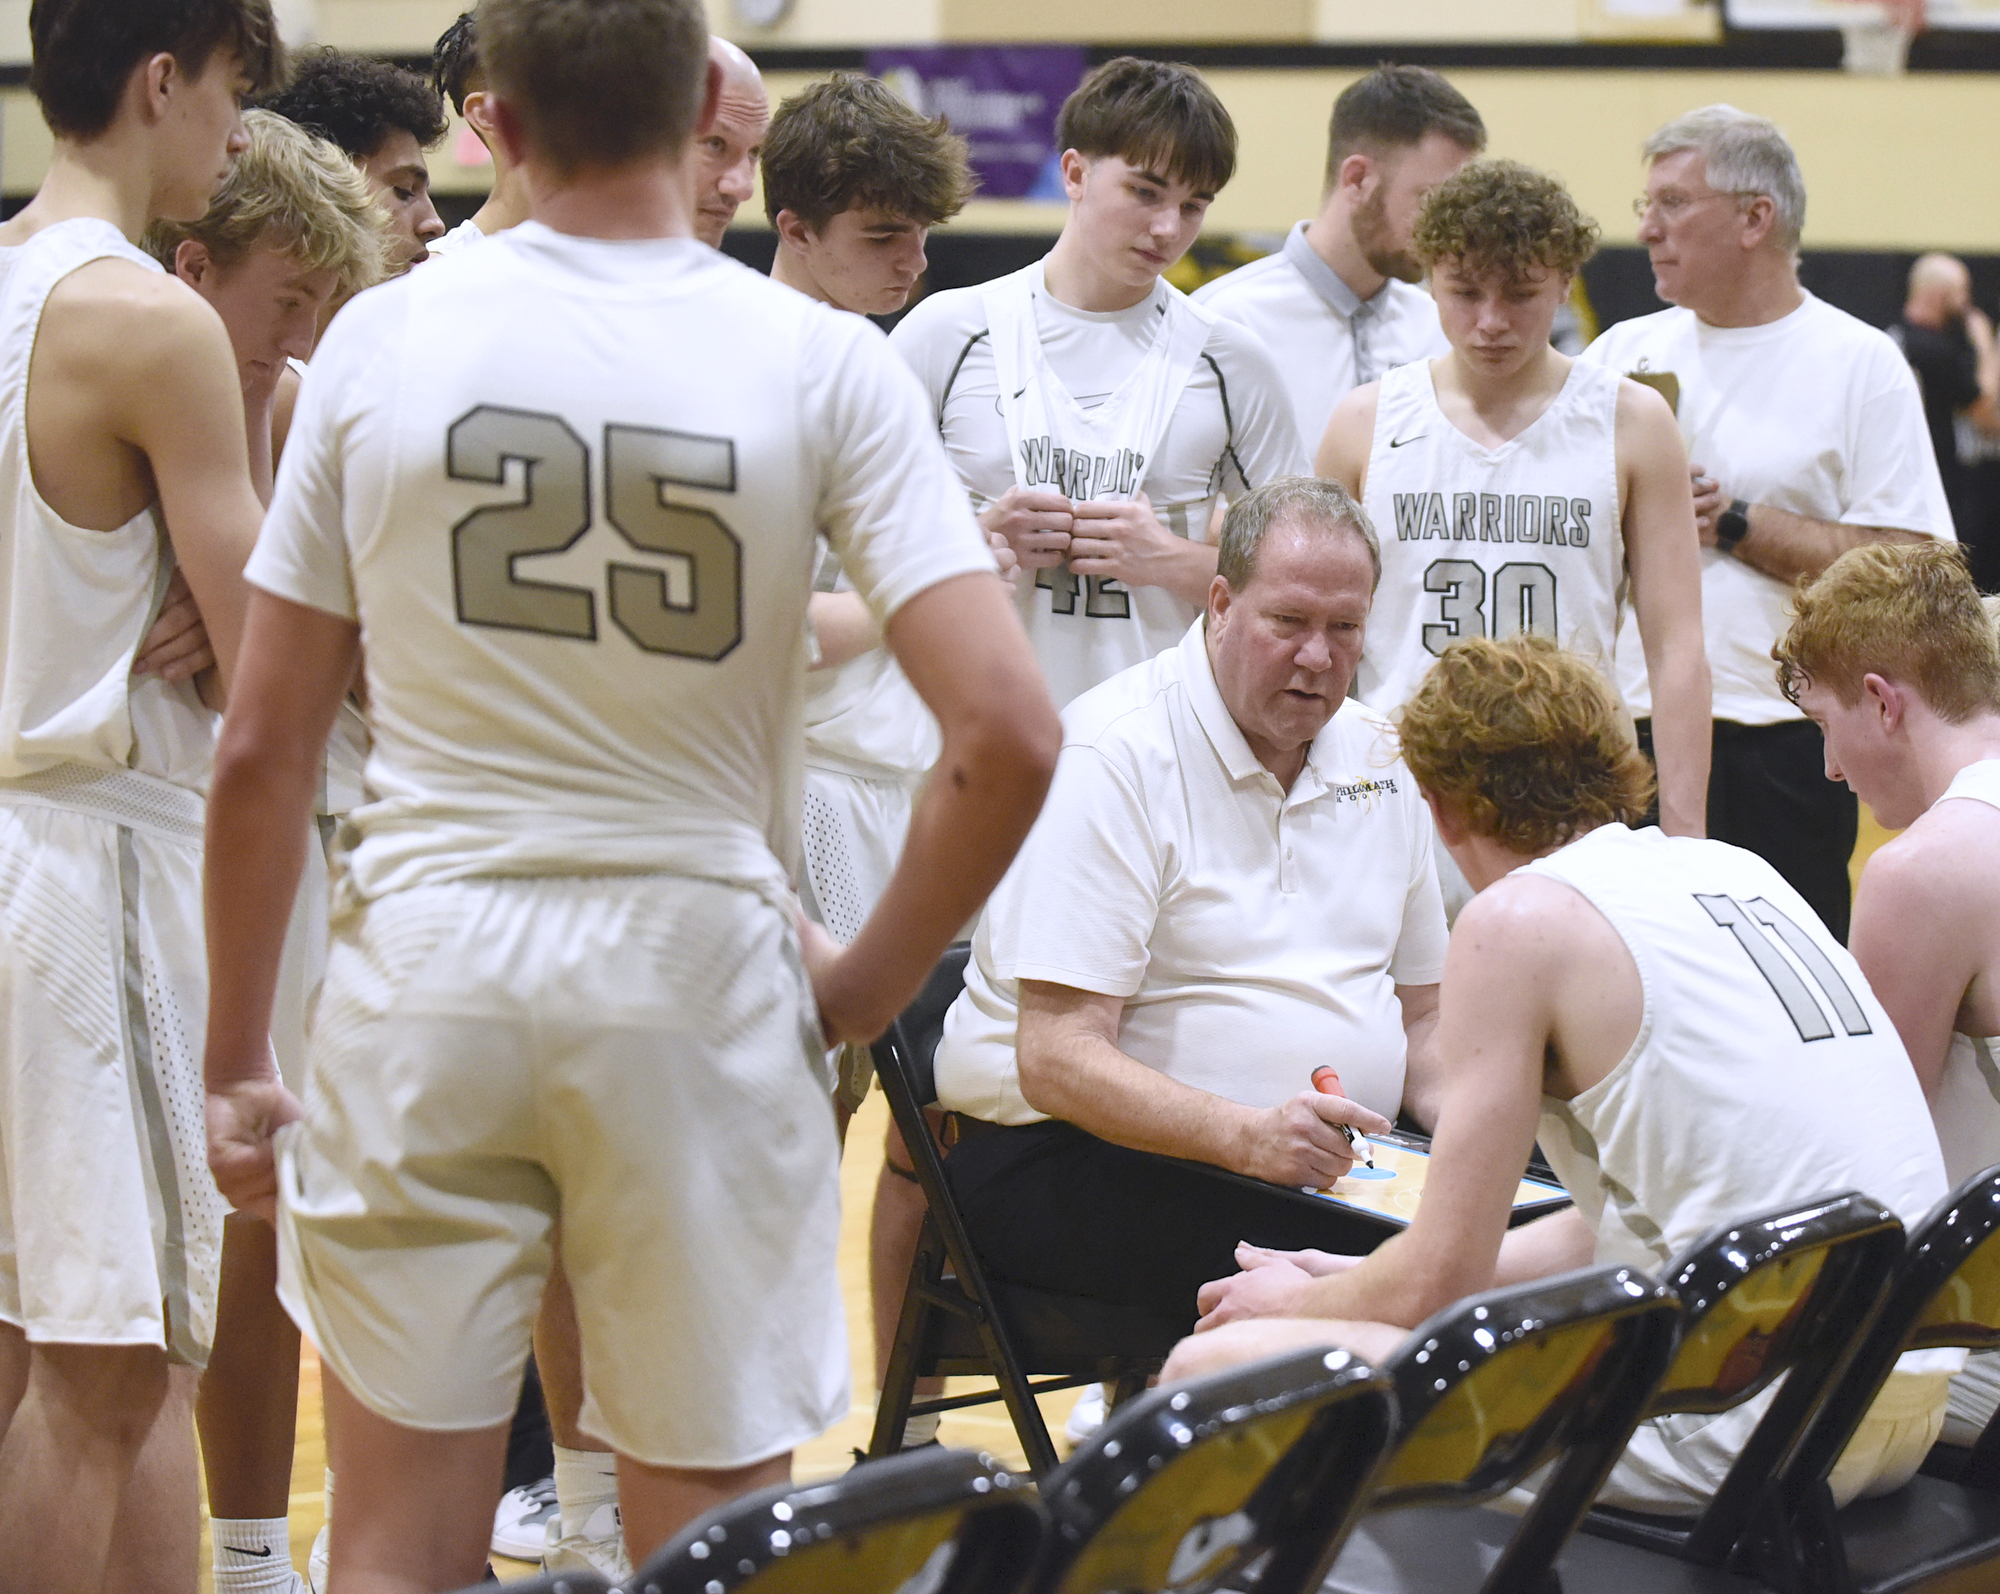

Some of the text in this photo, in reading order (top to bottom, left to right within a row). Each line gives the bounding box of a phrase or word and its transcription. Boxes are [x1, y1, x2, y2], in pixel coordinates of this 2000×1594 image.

[446, 403, 743, 663] 25
[1393, 491, 1592, 548] WARRIORS
[1421, 557, 1558, 658] 30
[1335, 779, 1395, 796] PHILOMATH
[1690, 892, 1874, 1043] 11
